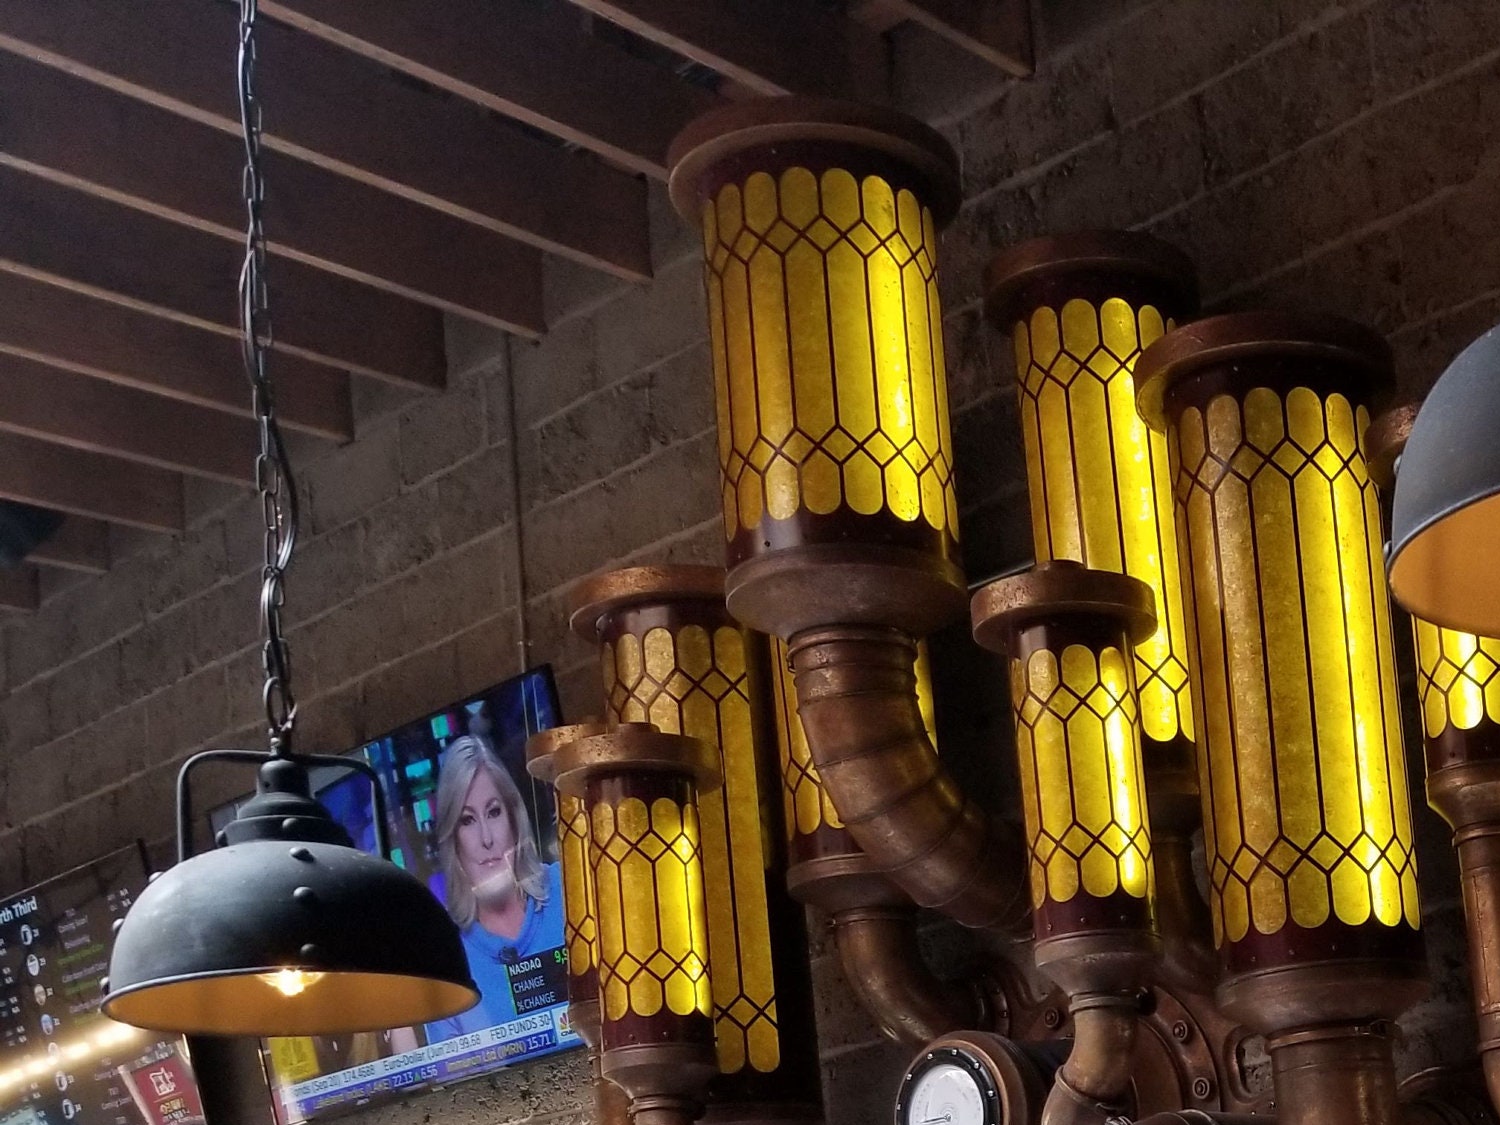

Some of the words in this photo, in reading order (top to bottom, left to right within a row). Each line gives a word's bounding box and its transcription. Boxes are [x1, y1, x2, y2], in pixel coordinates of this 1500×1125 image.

[14, 896, 38, 917] Third
[509, 958, 541, 976] NASDAQ
[513, 975, 545, 993] CHANGE
[524, 991, 556, 1010] CHANGE
[459, 1034, 481, 1051] 99.68
[491, 1026, 507, 1041] FED
[507, 1017, 537, 1036] FUNDS
[528, 1033, 551, 1050] 15.71
